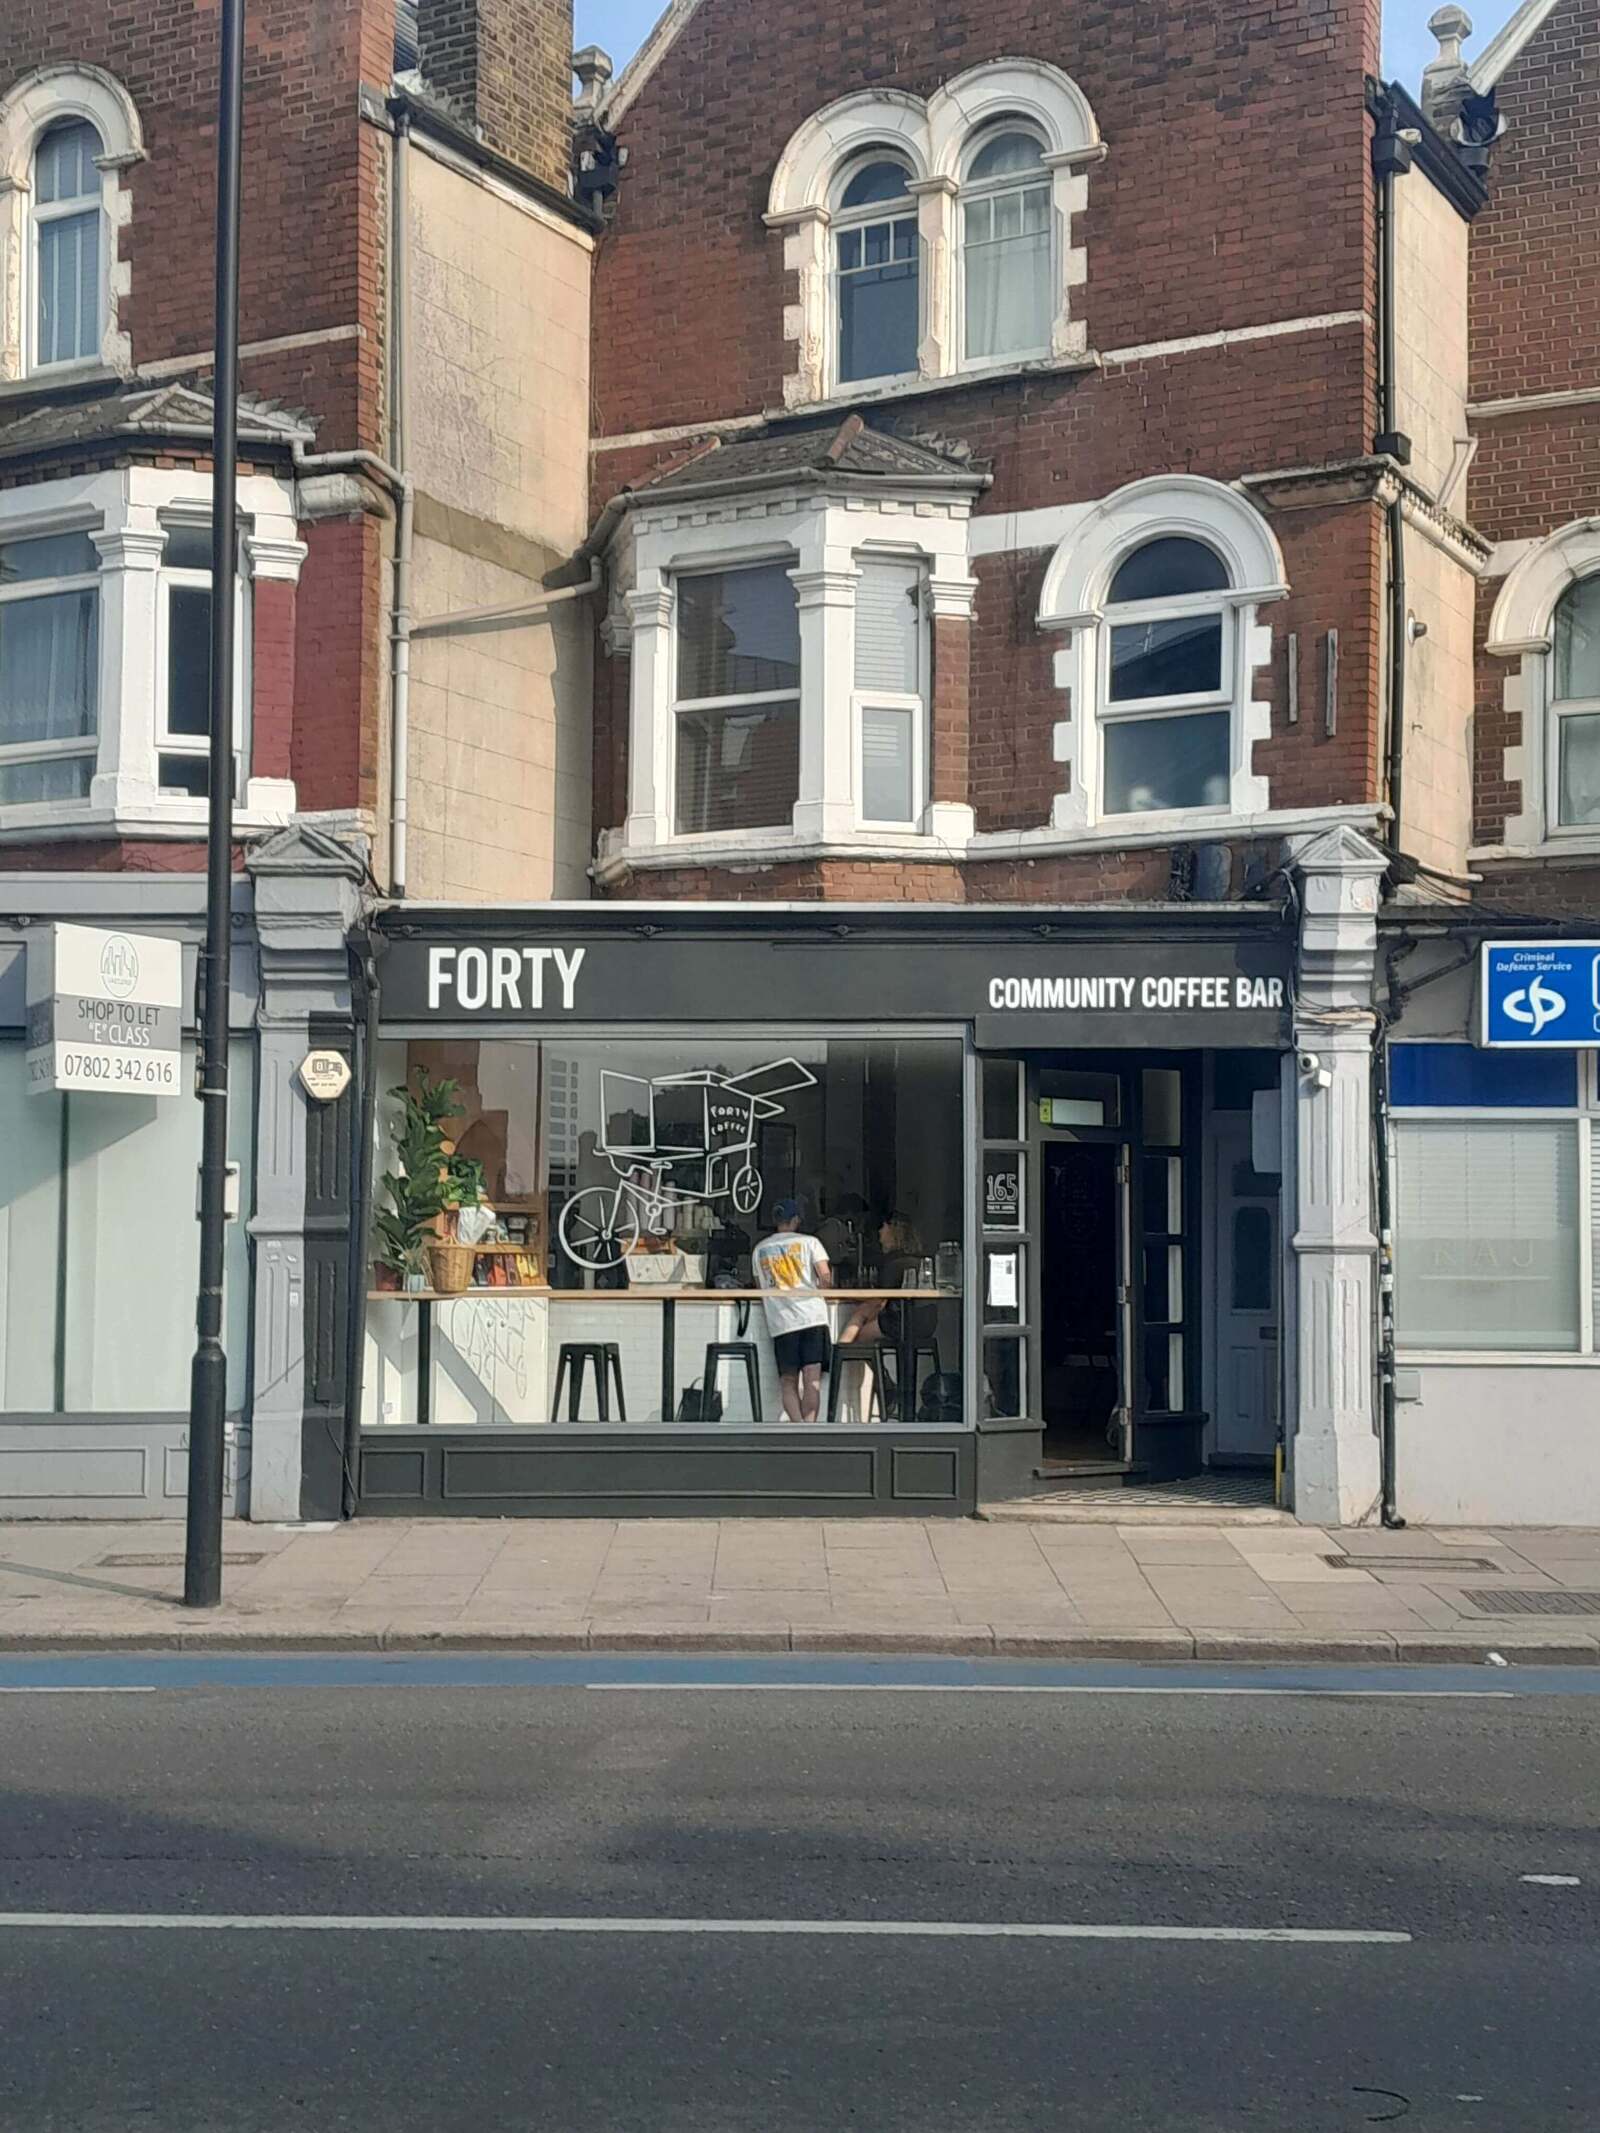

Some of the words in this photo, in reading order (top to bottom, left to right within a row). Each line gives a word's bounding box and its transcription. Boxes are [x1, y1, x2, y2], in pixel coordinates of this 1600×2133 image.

[1496, 963, 1535, 973] Defence
[1536, 962, 1572, 971] Service
[1513, 952, 1555, 962] Criminal
[427, 946, 587, 1010] FORTY
[988, 977, 1135, 1009] COMMUNITY
[1140, 977, 1230, 1009] COFFEE
[1236, 977, 1284, 1008] BAR
[78, 999, 115, 1021] SHOP
[118, 1003, 135, 1023] TO
[138, 1006, 161, 1026] LET
[108, 1025, 151, 1047] CLASS
[65, 1054, 111, 1079] 07802
[115, 1058, 142, 1081] 342
[146, 1062, 173, 1083] 616
[710, 1105, 749, 1120] FORTY
[711, 1121, 746, 1136] COFFEE
[986, 1173, 1018, 1201] 165
